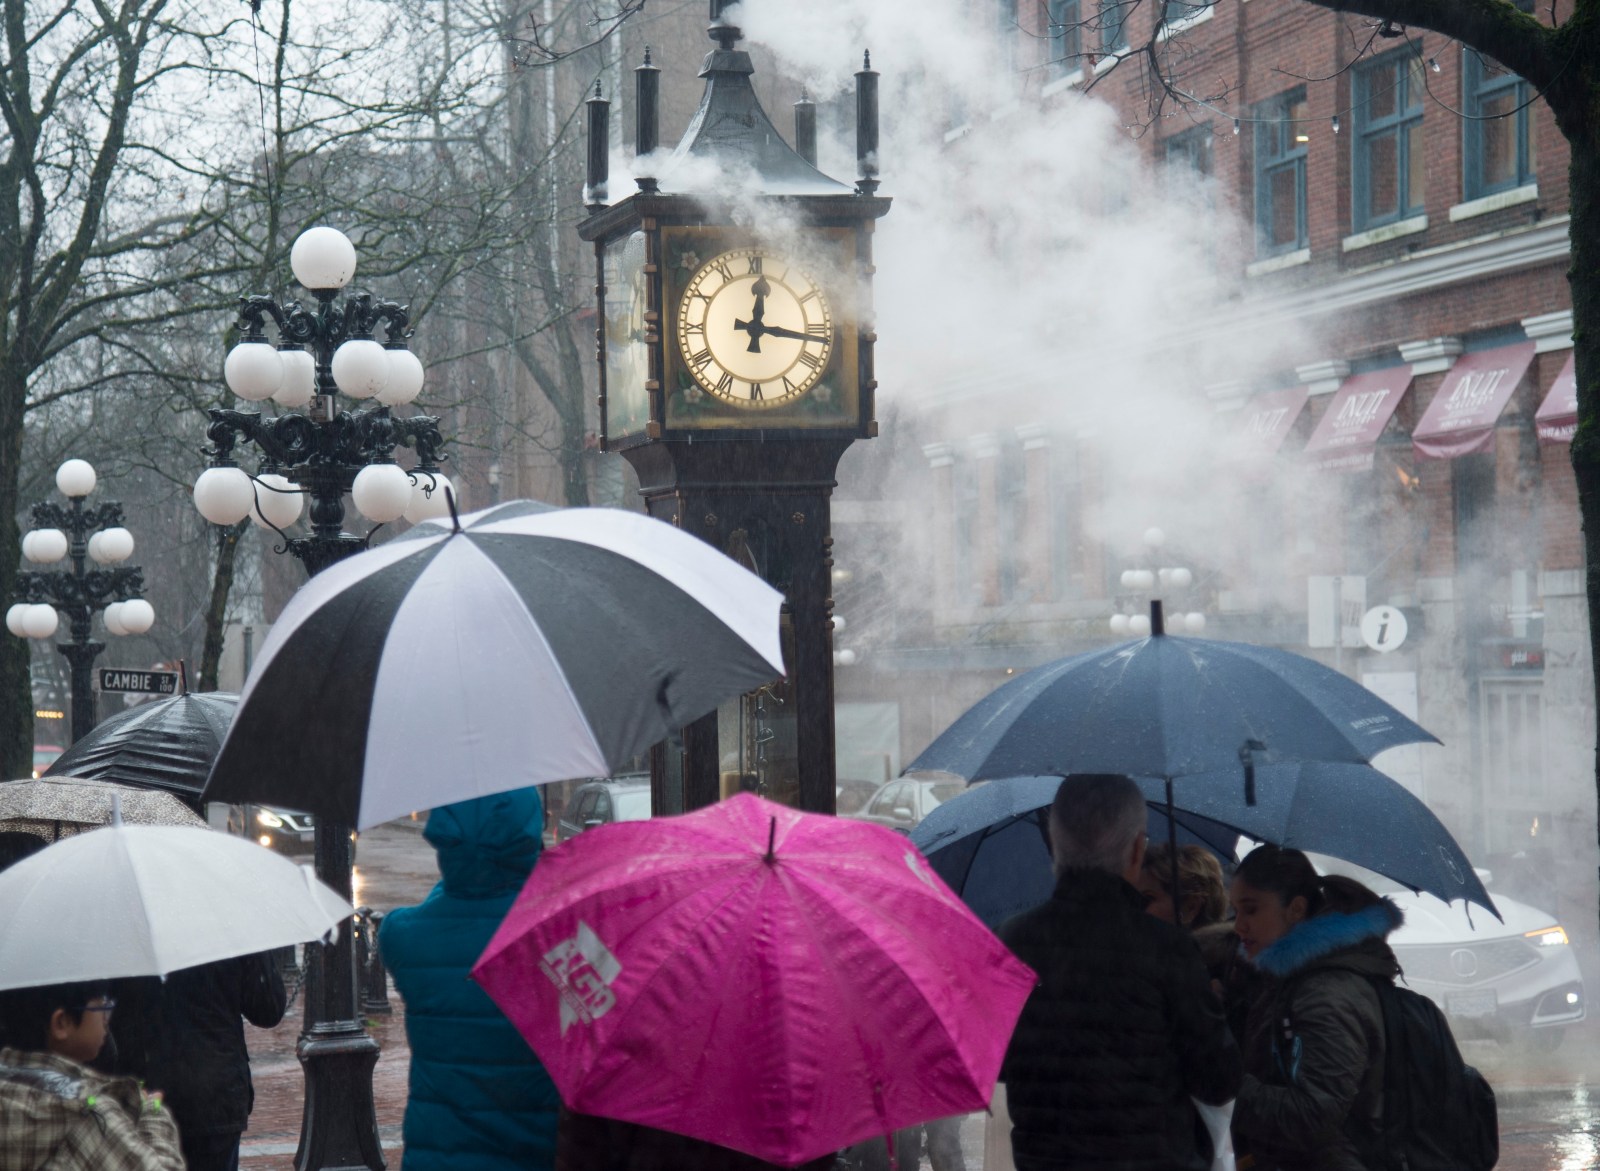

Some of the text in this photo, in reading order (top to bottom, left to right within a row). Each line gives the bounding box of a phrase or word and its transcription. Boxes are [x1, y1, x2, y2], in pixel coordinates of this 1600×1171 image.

[716, 263, 734, 284] XI
[748, 256, 763, 275] XII
[692, 288, 712, 305] X
[686, 322, 704, 334] IX
[716, 371, 734, 398] VII
[751, 383, 764, 400] VI
[782, 375, 796, 393] V
[104, 672, 170, 690] CAMBIE ST
[160, 684, 174, 692] 100
